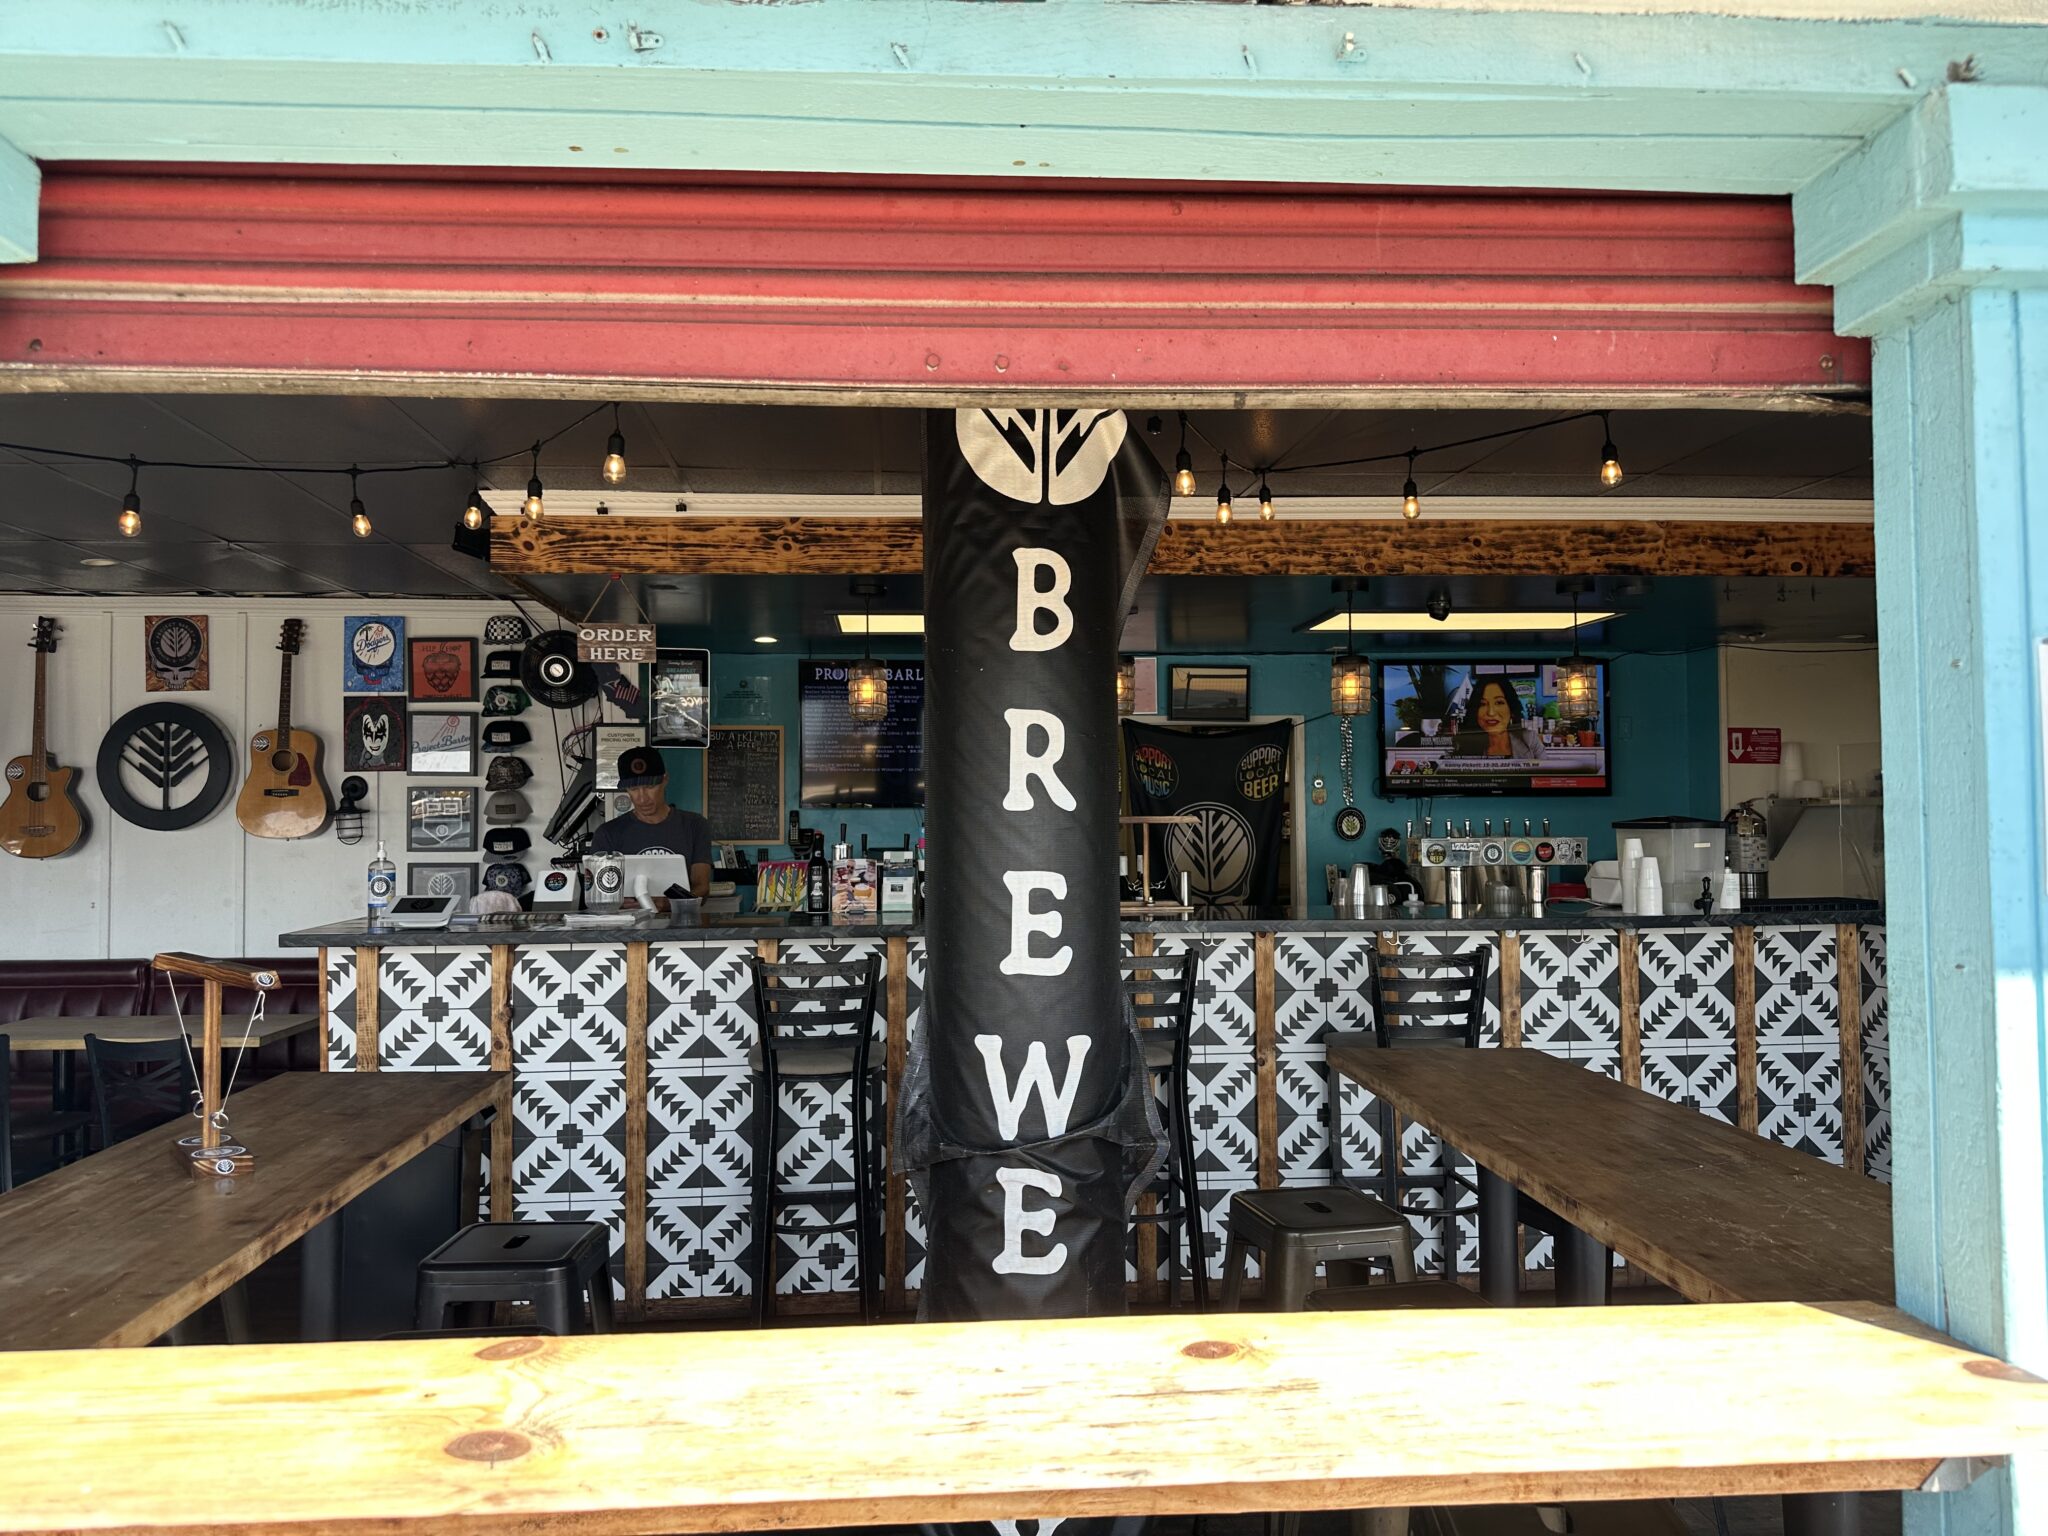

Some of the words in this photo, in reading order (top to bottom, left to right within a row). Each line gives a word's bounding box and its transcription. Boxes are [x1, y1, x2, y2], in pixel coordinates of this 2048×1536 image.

[356, 635, 391, 652] Dodgers
[580, 629, 653, 642] ORDER
[590, 647, 644, 660] HERE
[1135, 747, 1172, 770] SUPPORT
[1241, 746, 1281, 770] SUPPORT
[1239, 762, 1281, 781] LOCAL
[1139, 773, 1169, 796] MUSIC
[1244, 774, 1279, 798] BEER
